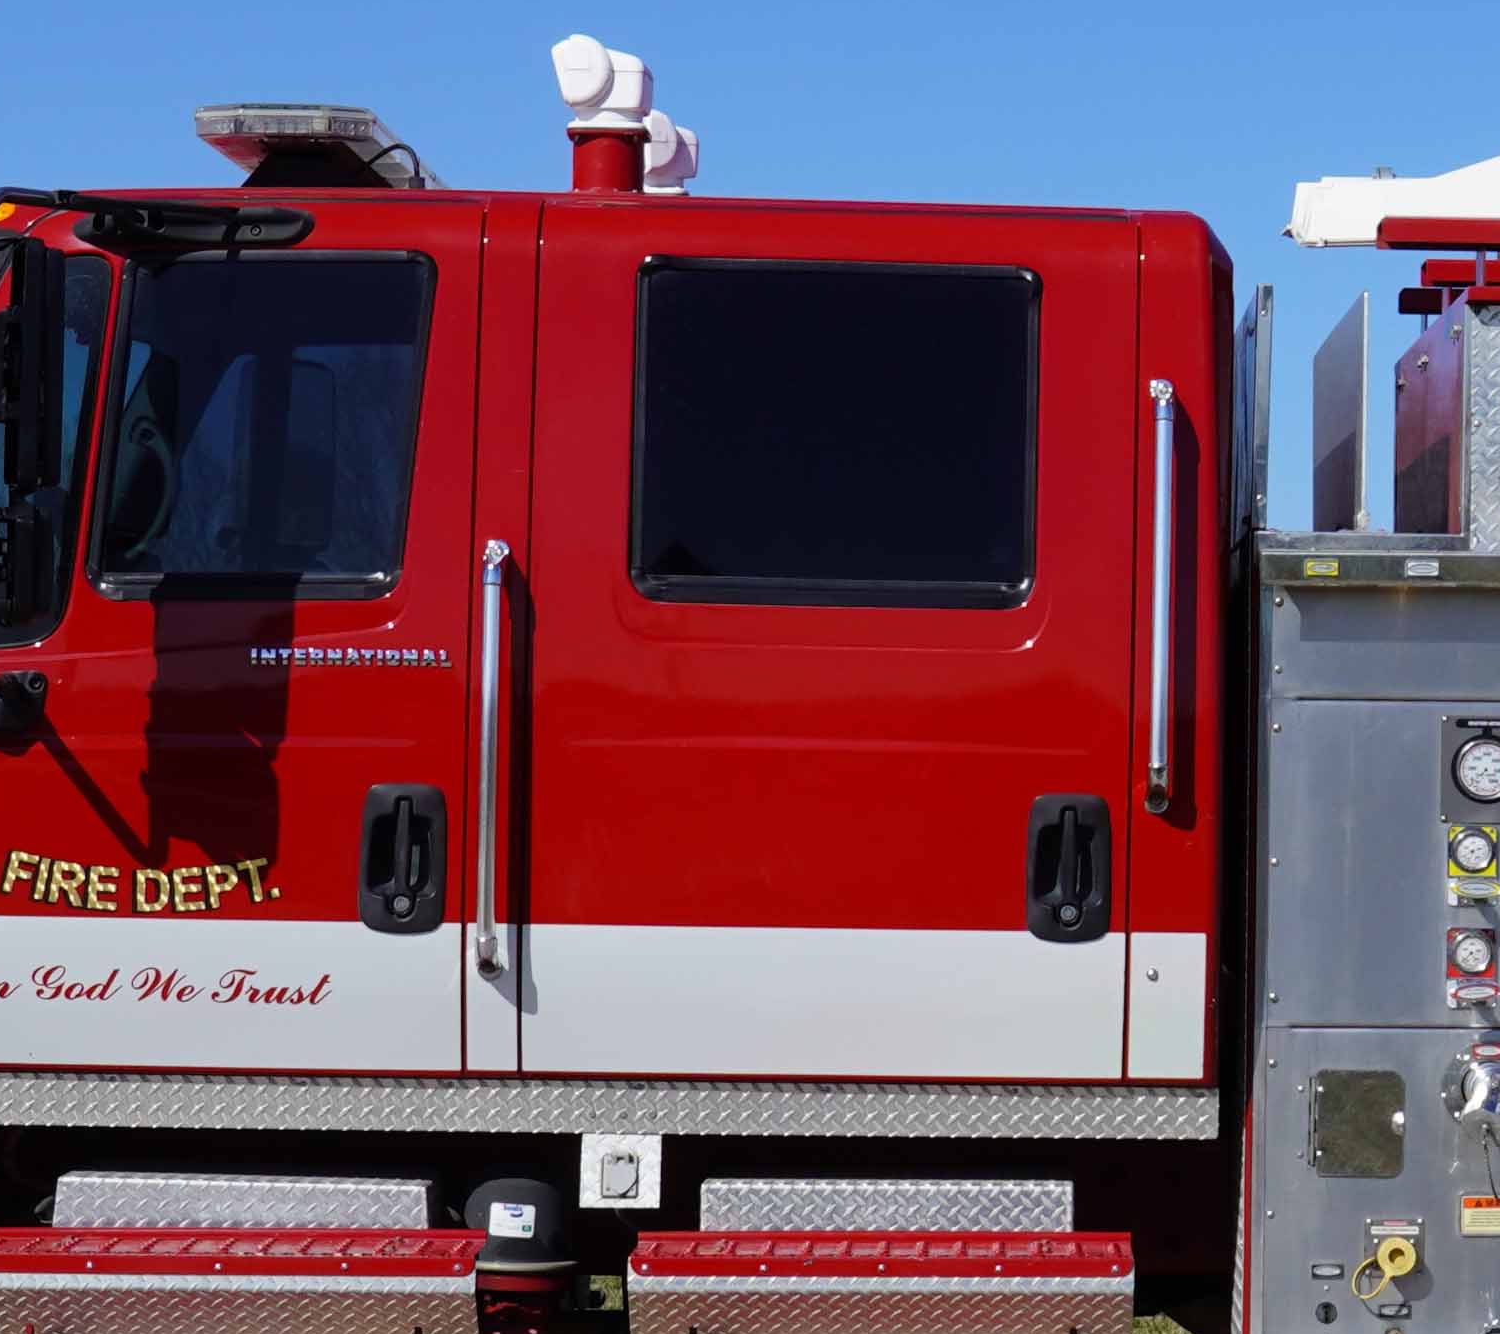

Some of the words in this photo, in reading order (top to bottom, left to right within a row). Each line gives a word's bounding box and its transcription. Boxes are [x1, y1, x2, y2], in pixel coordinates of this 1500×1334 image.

[251, 647, 452, 668] INTERNATIONAL
[1, 850, 120, 913] FIRE
[133, 857, 282, 913] DEPT.
[31, 965, 122, 1003] God
[131, 966, 205, 1004] We
[211, 969, 333, 1006] Trust
